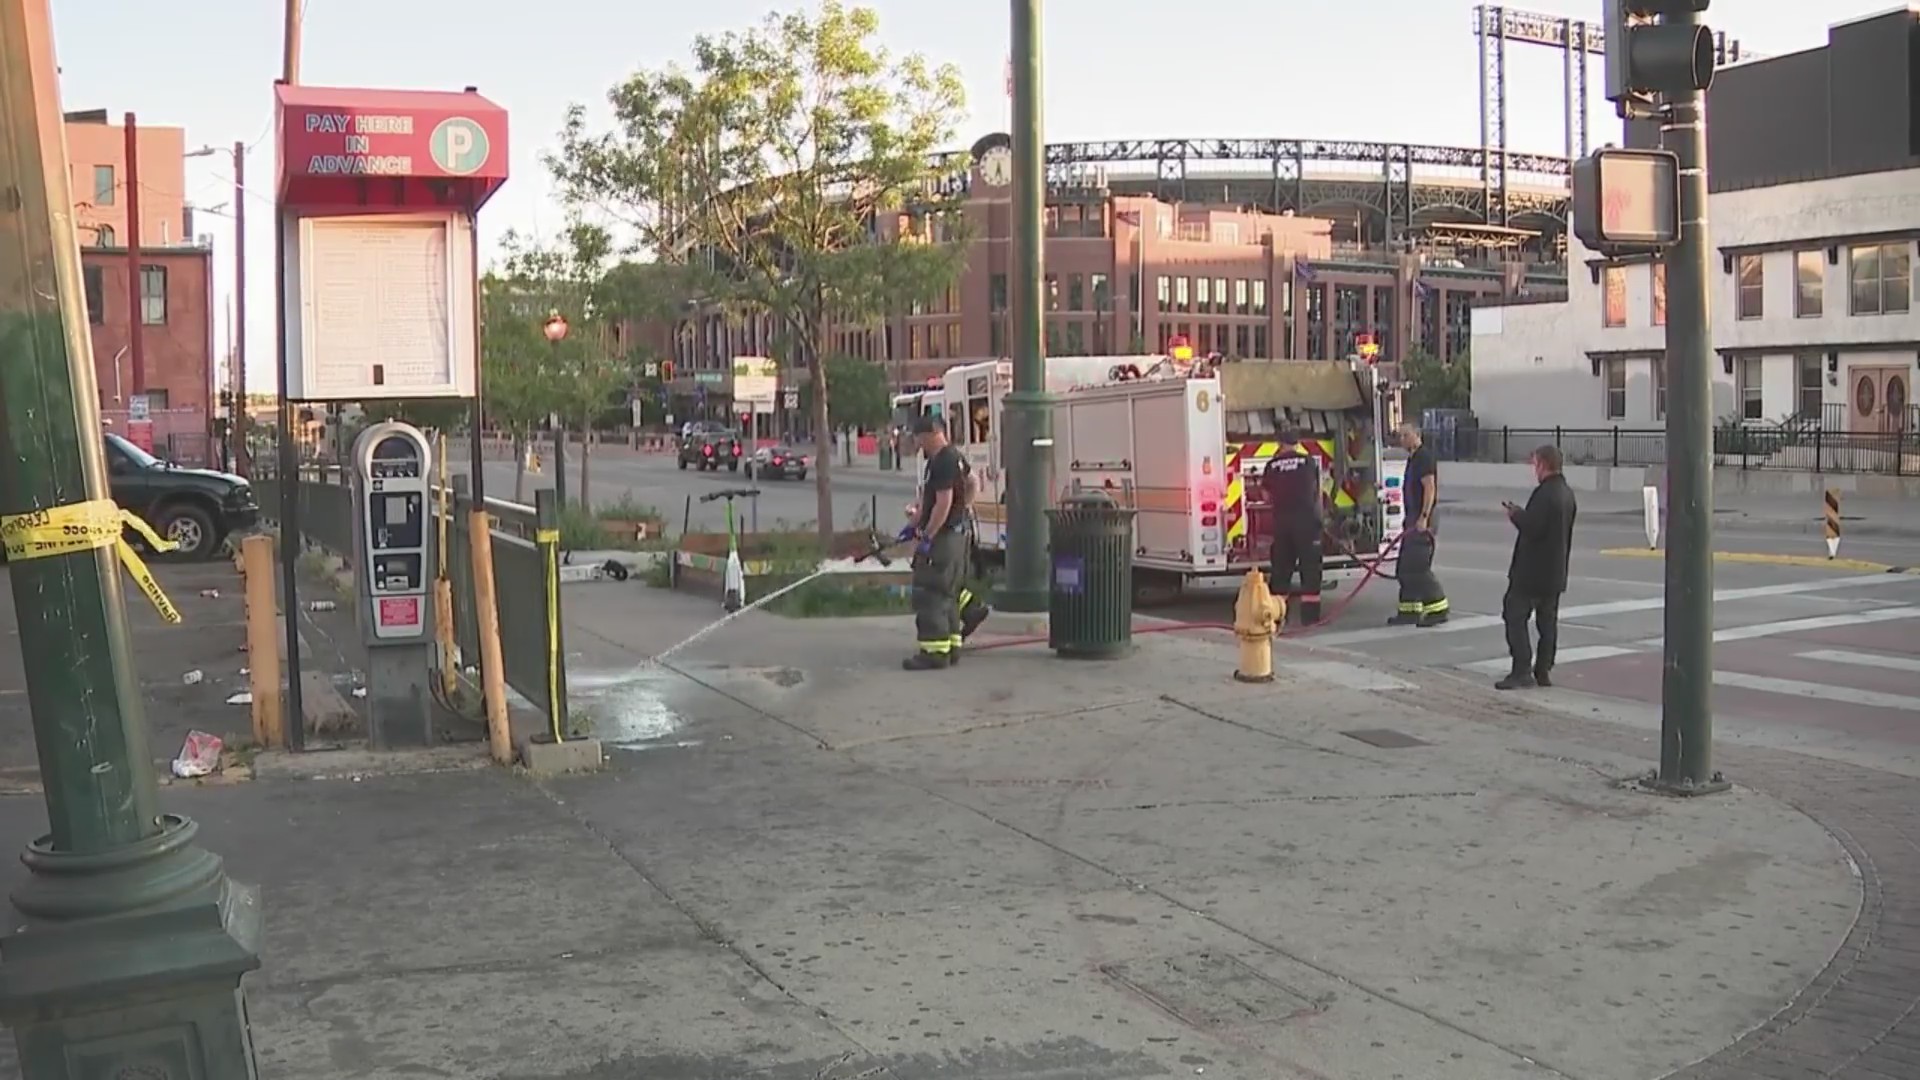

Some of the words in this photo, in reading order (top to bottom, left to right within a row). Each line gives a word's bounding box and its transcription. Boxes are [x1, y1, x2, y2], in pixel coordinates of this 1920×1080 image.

[306, 114, 350, 132] PAY
[355, 116, 413, 133] HERE
[346, 135, 368, 153] IN
[446, 126, 473, 168] P
[308, 155, 412, 174] ADVANCE
[1196, 390, 1210, 413] 6
